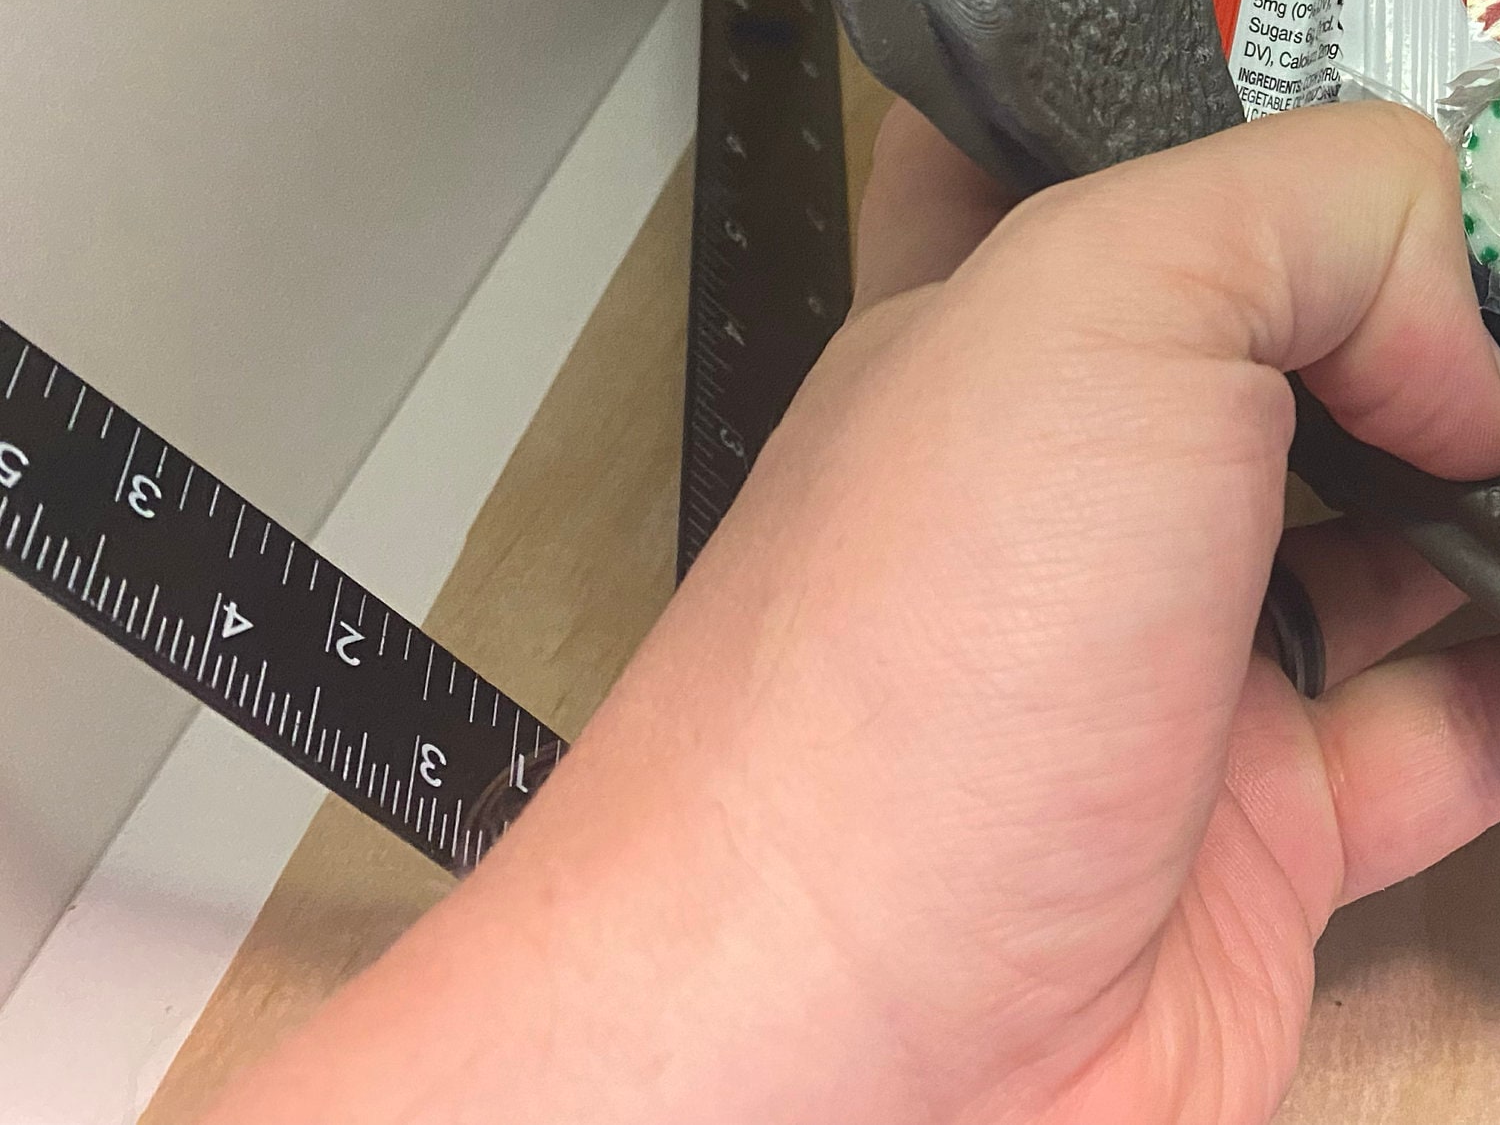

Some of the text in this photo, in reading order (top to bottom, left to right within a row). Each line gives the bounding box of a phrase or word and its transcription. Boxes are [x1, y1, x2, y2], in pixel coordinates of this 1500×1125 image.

[1248, 16, 1304, 45] Sugars
[1243, 40, 1275, 68] DV),
[0, 440, 30, 489] 5
[127, 474, 163, 519] 3
[222, 601, 254, 639] 4
[335, 620, 366, 667] 2
[419, 743, 447, 788] 3
[515, 753, 529, 794] 1
